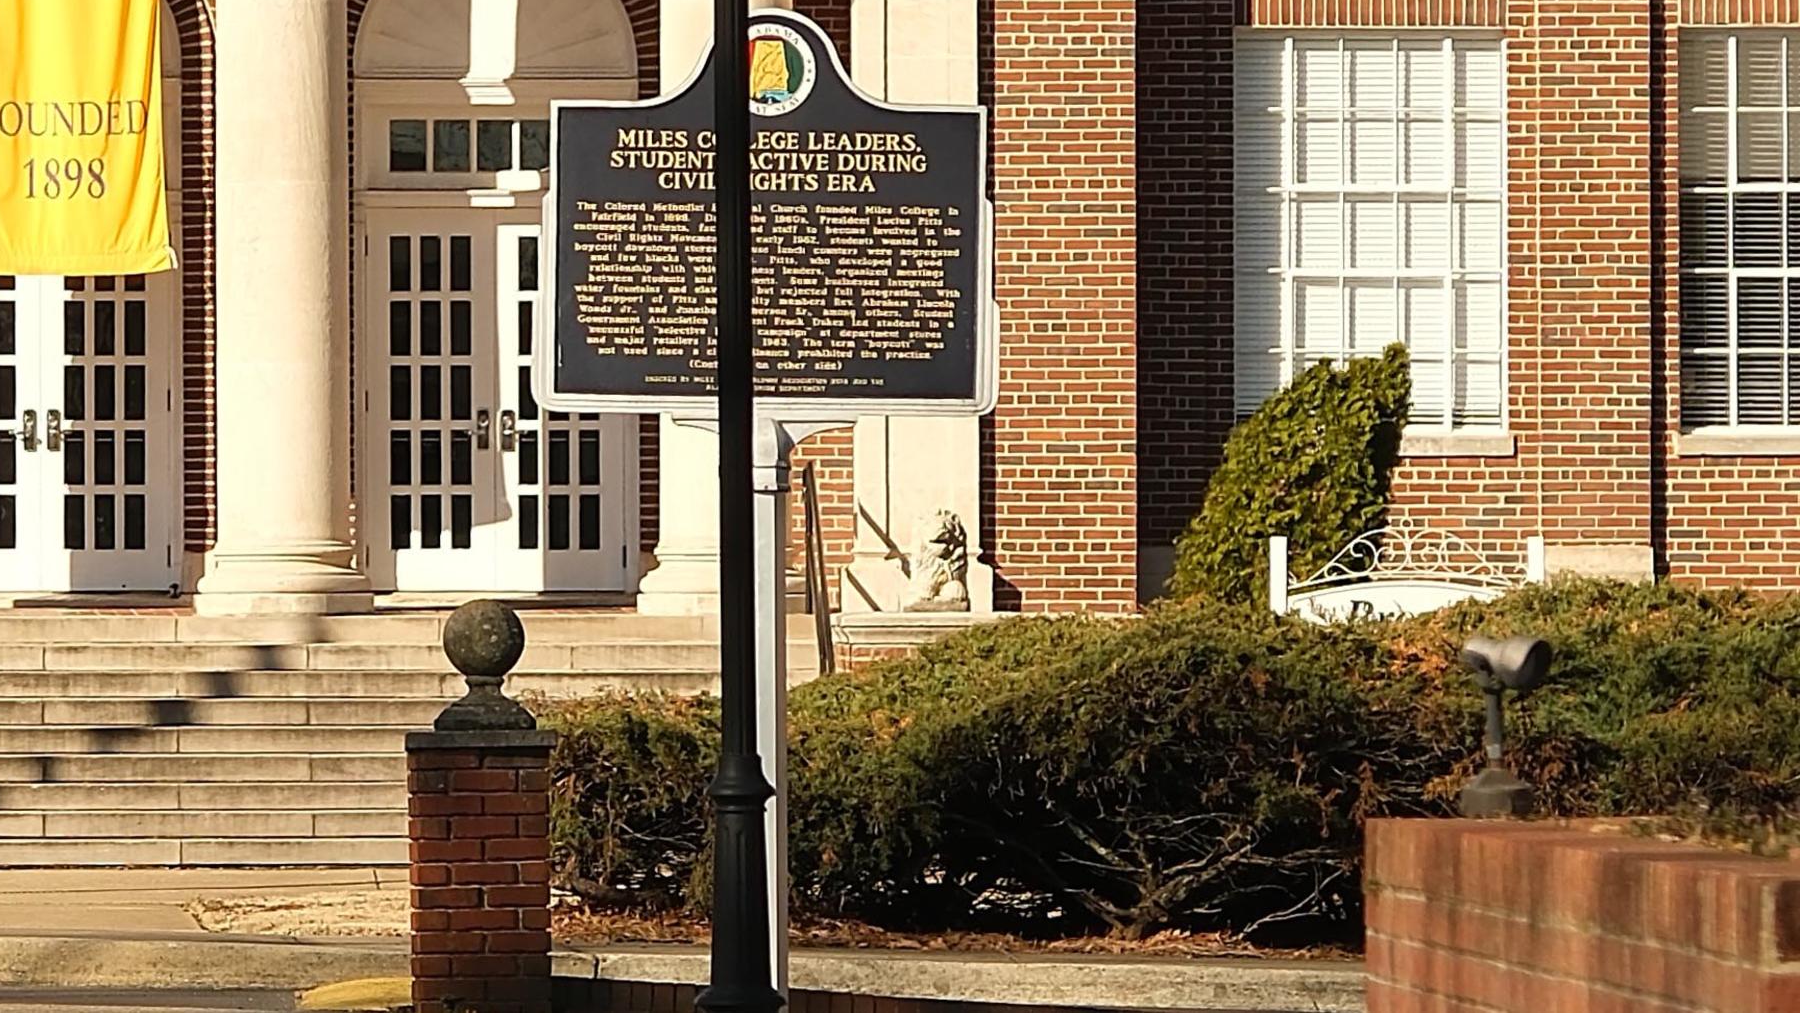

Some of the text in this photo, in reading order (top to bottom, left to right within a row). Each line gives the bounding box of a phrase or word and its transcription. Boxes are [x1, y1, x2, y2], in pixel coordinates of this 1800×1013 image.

[617, 129, 689, 148] MILES
[697, 131, 800, 151] CEGE
[610, 150, 928, 173] STUDENT ACTIVE DURING
[23, 158, 106, 200] 1898
[658, 171, 876, 192] CIVIL IGHTS ERA
